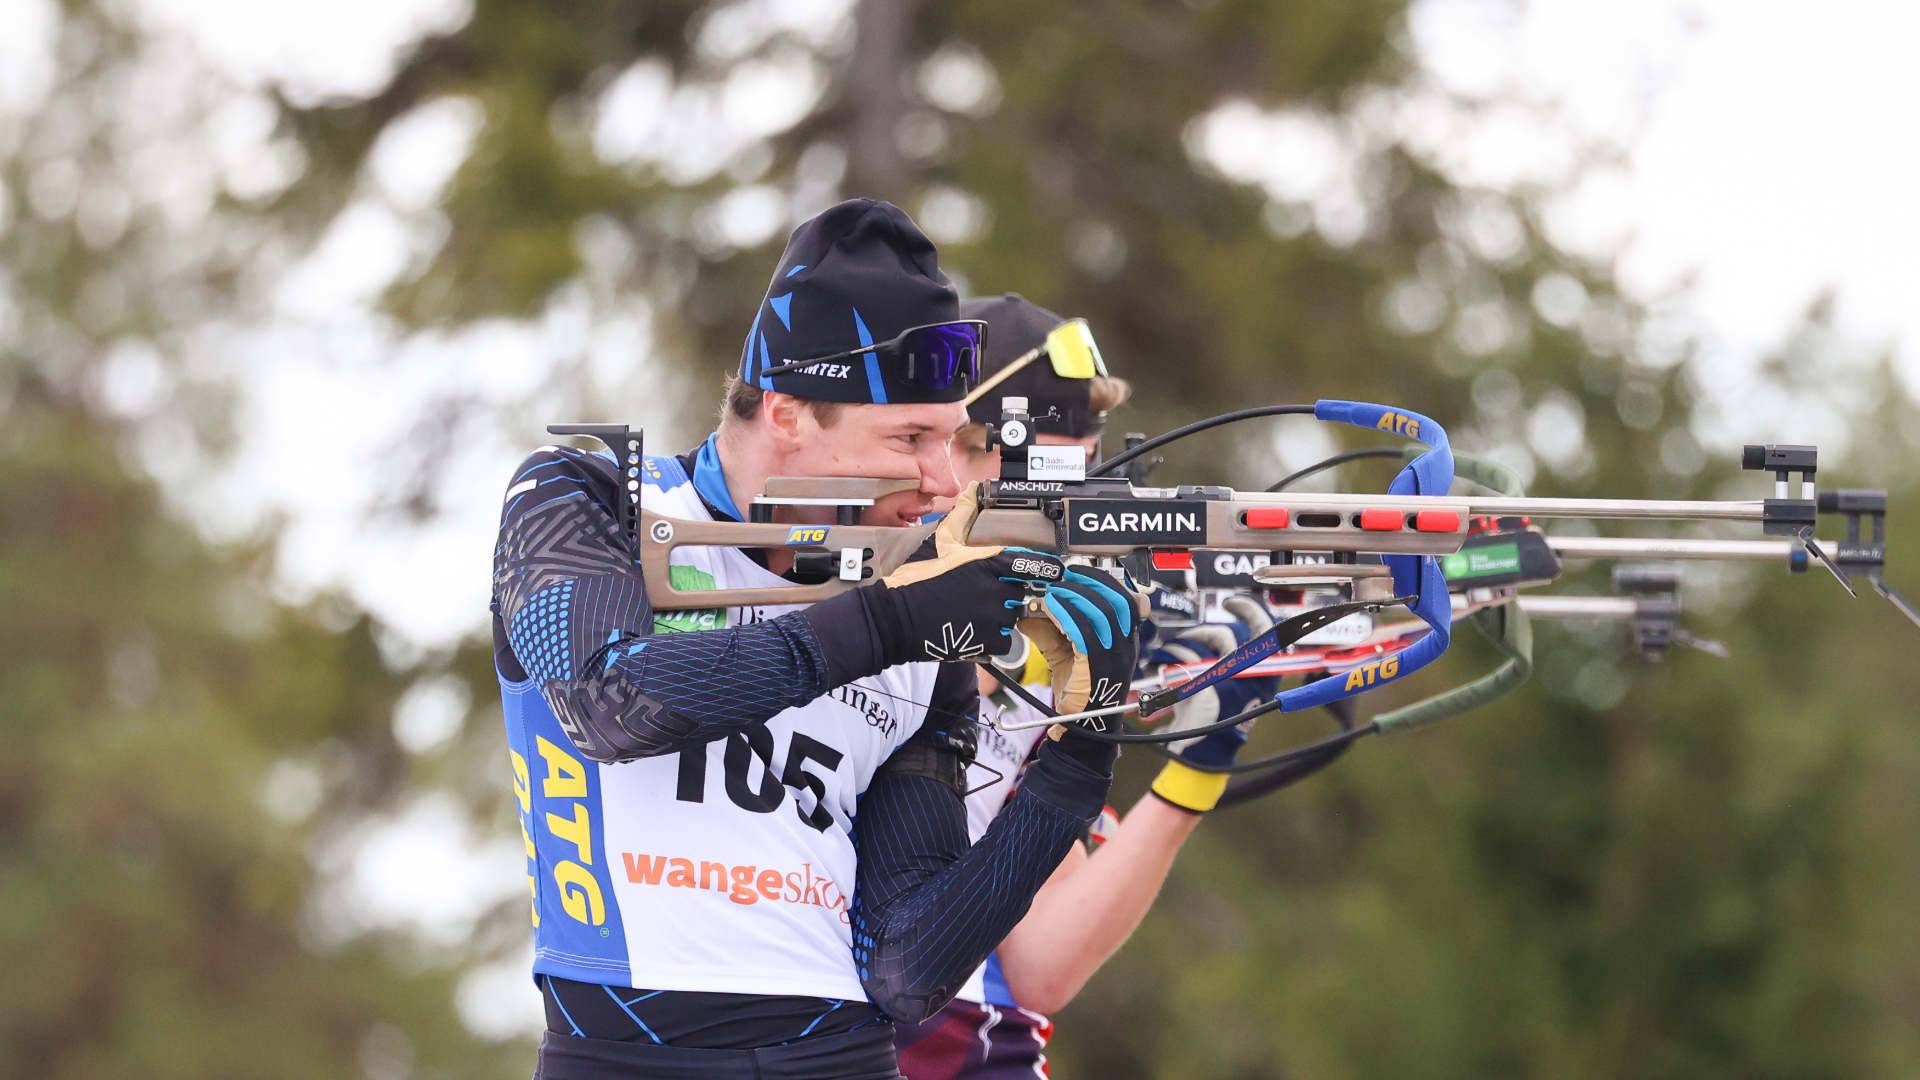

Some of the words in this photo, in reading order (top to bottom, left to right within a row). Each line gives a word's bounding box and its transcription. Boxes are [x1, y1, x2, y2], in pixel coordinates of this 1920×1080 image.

[1376, 411, 1420, 440] ATG
[789, 529, 826, 542] ATG
[1213, 553, 1326, 575] GAIN
[1344, 656, 1399, 691] ATG
[675, 726, 844, 834] 105
[535, 734, 606, 926] ATG
